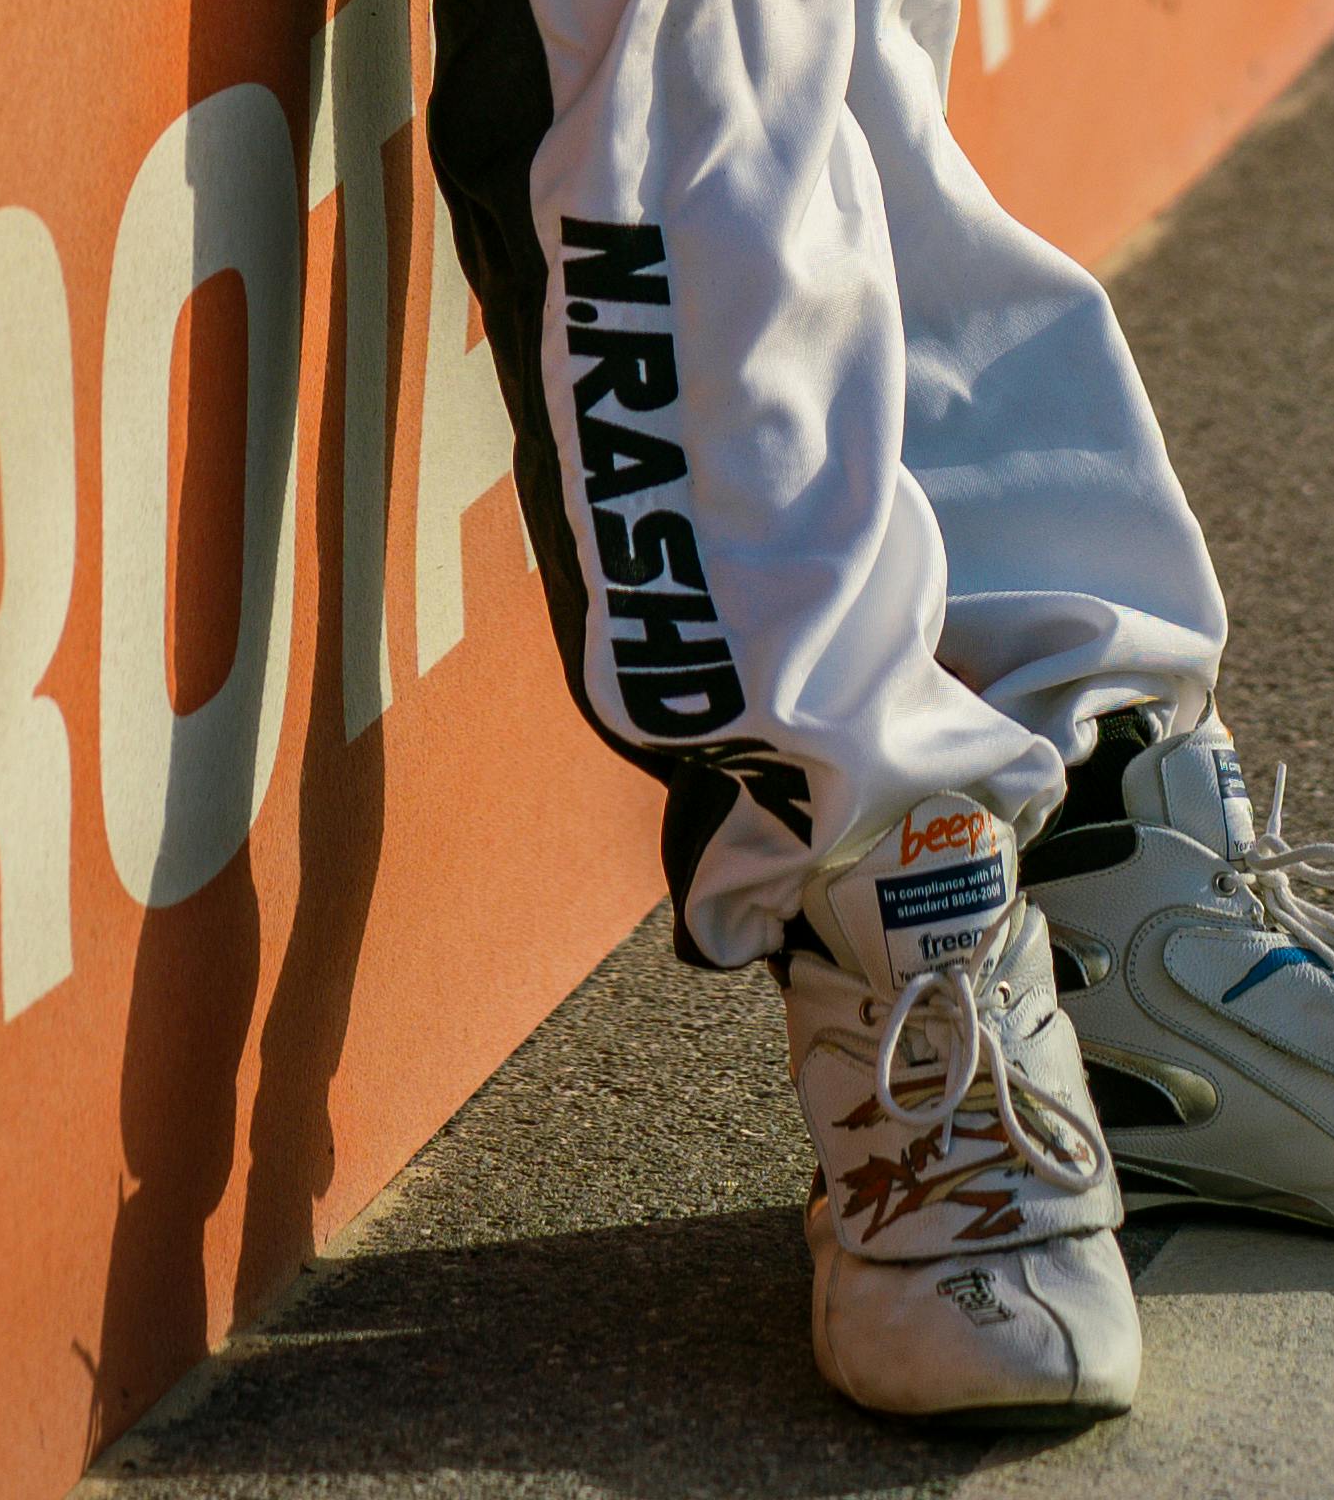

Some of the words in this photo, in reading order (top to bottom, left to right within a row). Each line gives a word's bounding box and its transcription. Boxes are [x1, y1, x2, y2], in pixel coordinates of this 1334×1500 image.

[883, 887, 896, 904] In
[899, 876, 966, 900] compliance
[967, 869, 989, 886] with
[897, 896, 949, 919] standard
